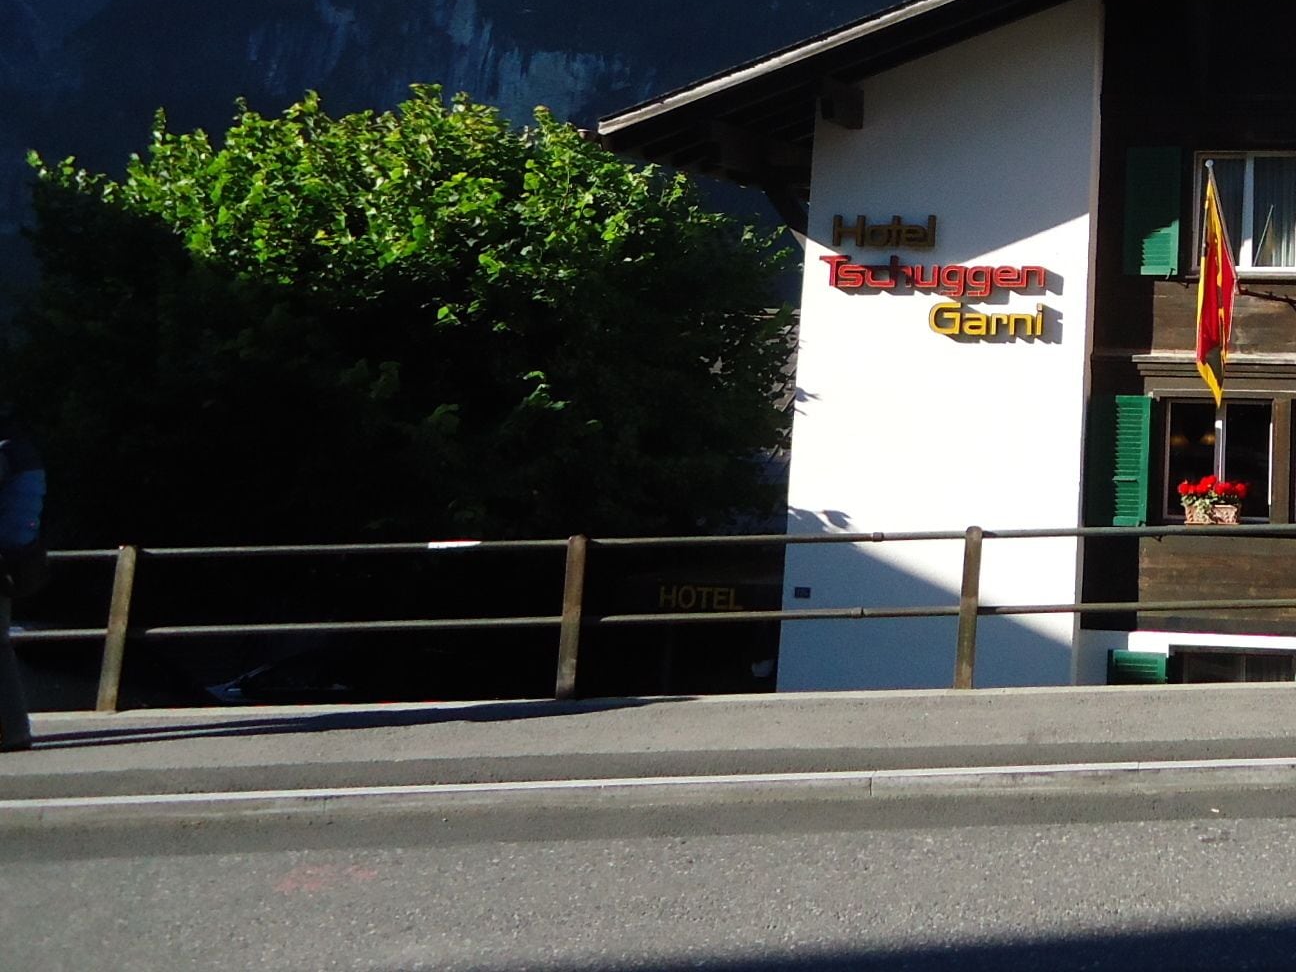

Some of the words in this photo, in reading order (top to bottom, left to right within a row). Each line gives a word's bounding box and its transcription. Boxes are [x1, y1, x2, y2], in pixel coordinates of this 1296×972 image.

[832, 214, 937, 247] Hotel
[819, 255, 1046, 296] Tschuggen
[928, 302, 1043, 336] Garni
[659, 585, 743, 610] HOTEL
